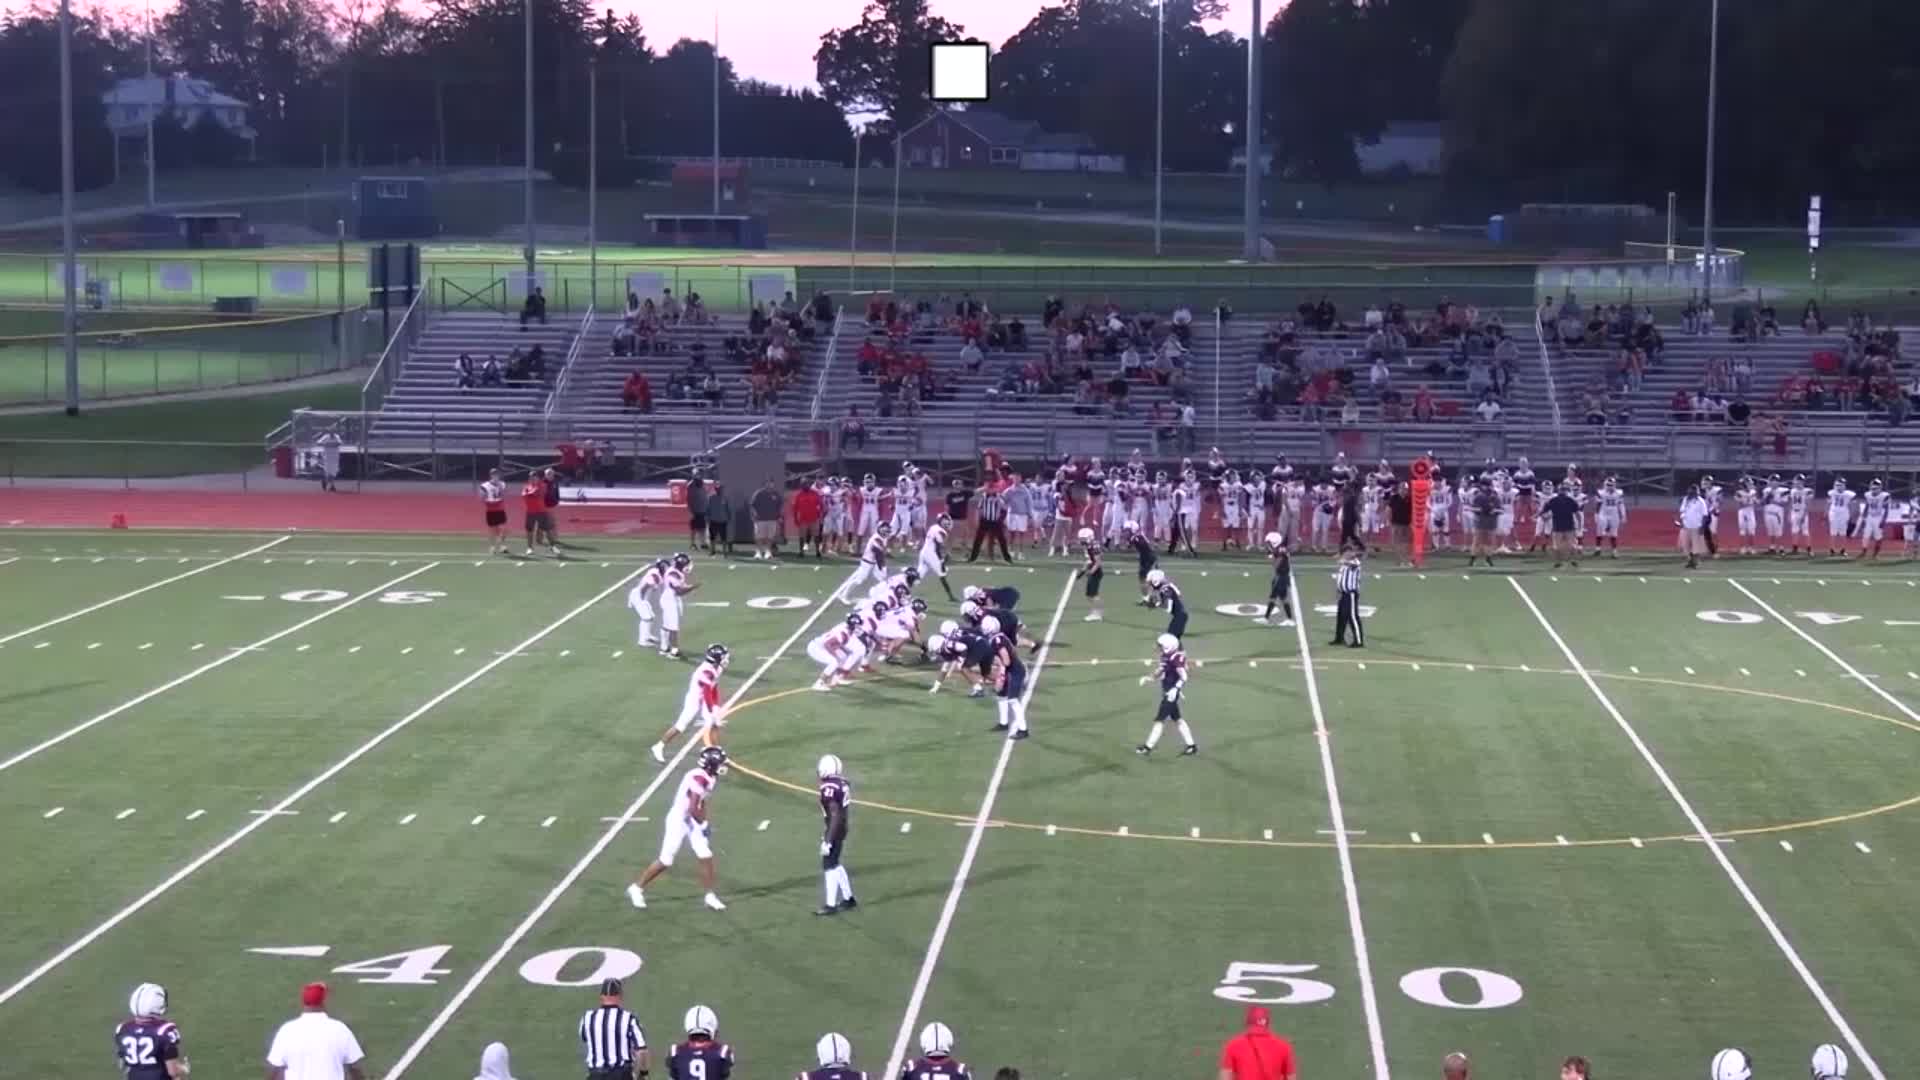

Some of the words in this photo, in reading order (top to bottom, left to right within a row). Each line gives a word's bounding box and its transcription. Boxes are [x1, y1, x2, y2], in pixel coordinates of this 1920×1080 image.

[332, 945, 642, 987] 40
[1213, 961, 1524, 1010] 50
[122, 1036, 157, 1065] 32
[689, 1058, 706, 1080] 9
